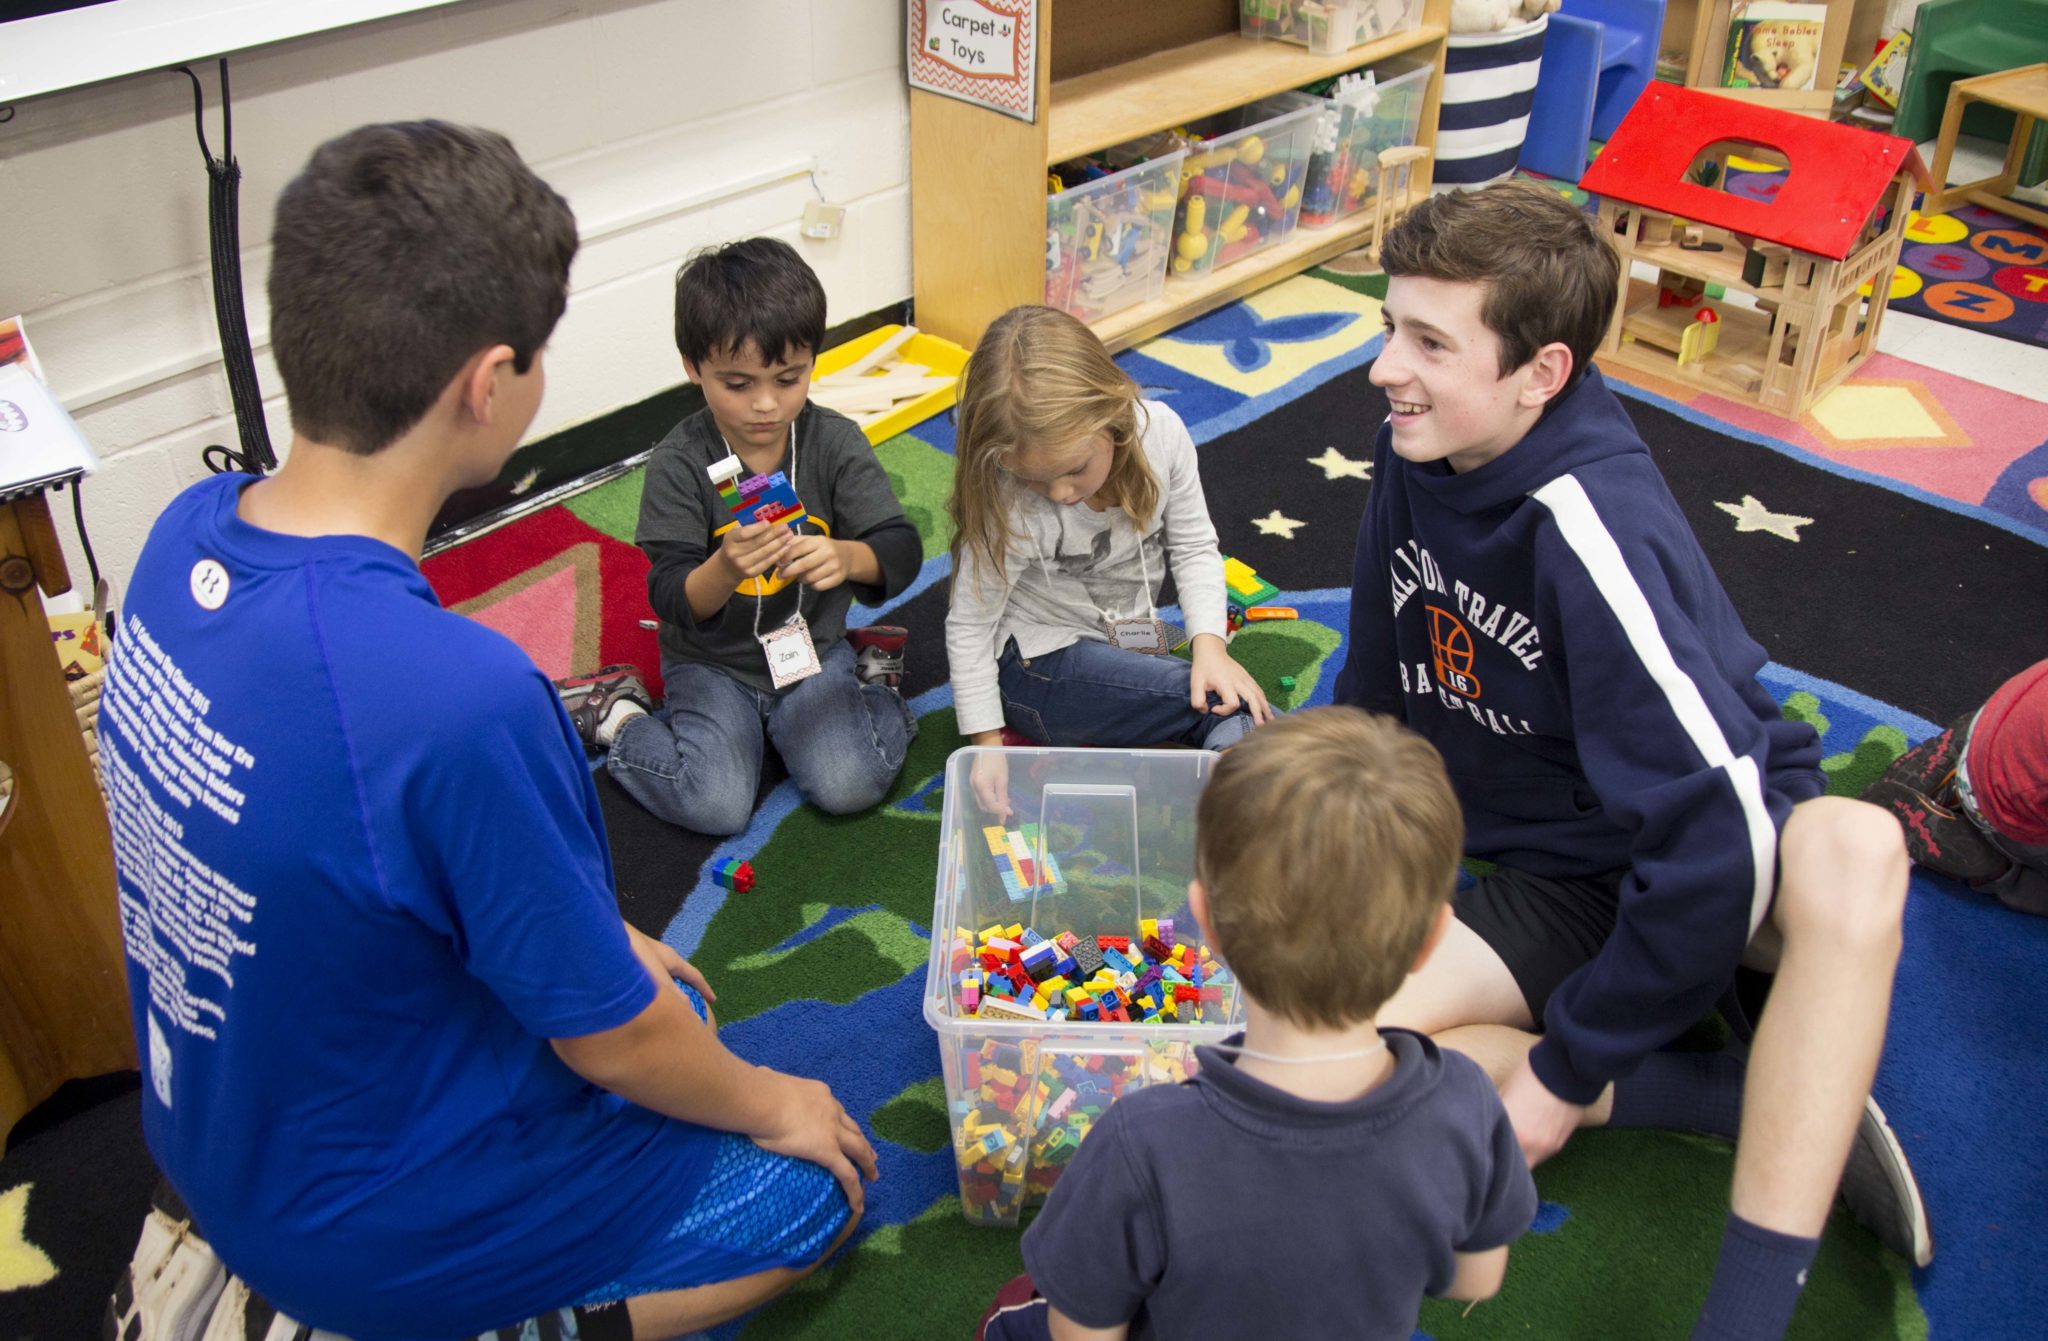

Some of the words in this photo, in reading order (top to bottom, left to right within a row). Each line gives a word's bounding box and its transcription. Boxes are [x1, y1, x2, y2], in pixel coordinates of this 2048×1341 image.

[942, 7, 995, 37] Carpet
[1782, 22, 1818, 36] Babies
[950, 37, 986, 65] Toys
[1766, 37, 1796, 50] Sleep
[1910, 217, 1937, 236] L
[1981, 234, 2044, 260] M
[1926, 253, 1966, 272] S
[1943, 289, 1997, 313] Z
[1454, 579, 1543, 671] TRAVEL
[779, 650, 800, 662] Zain
[1449, 670, 1467, 692] 16
[211, 731, 235, 757] New
[233, 746, 255, 770] Era
